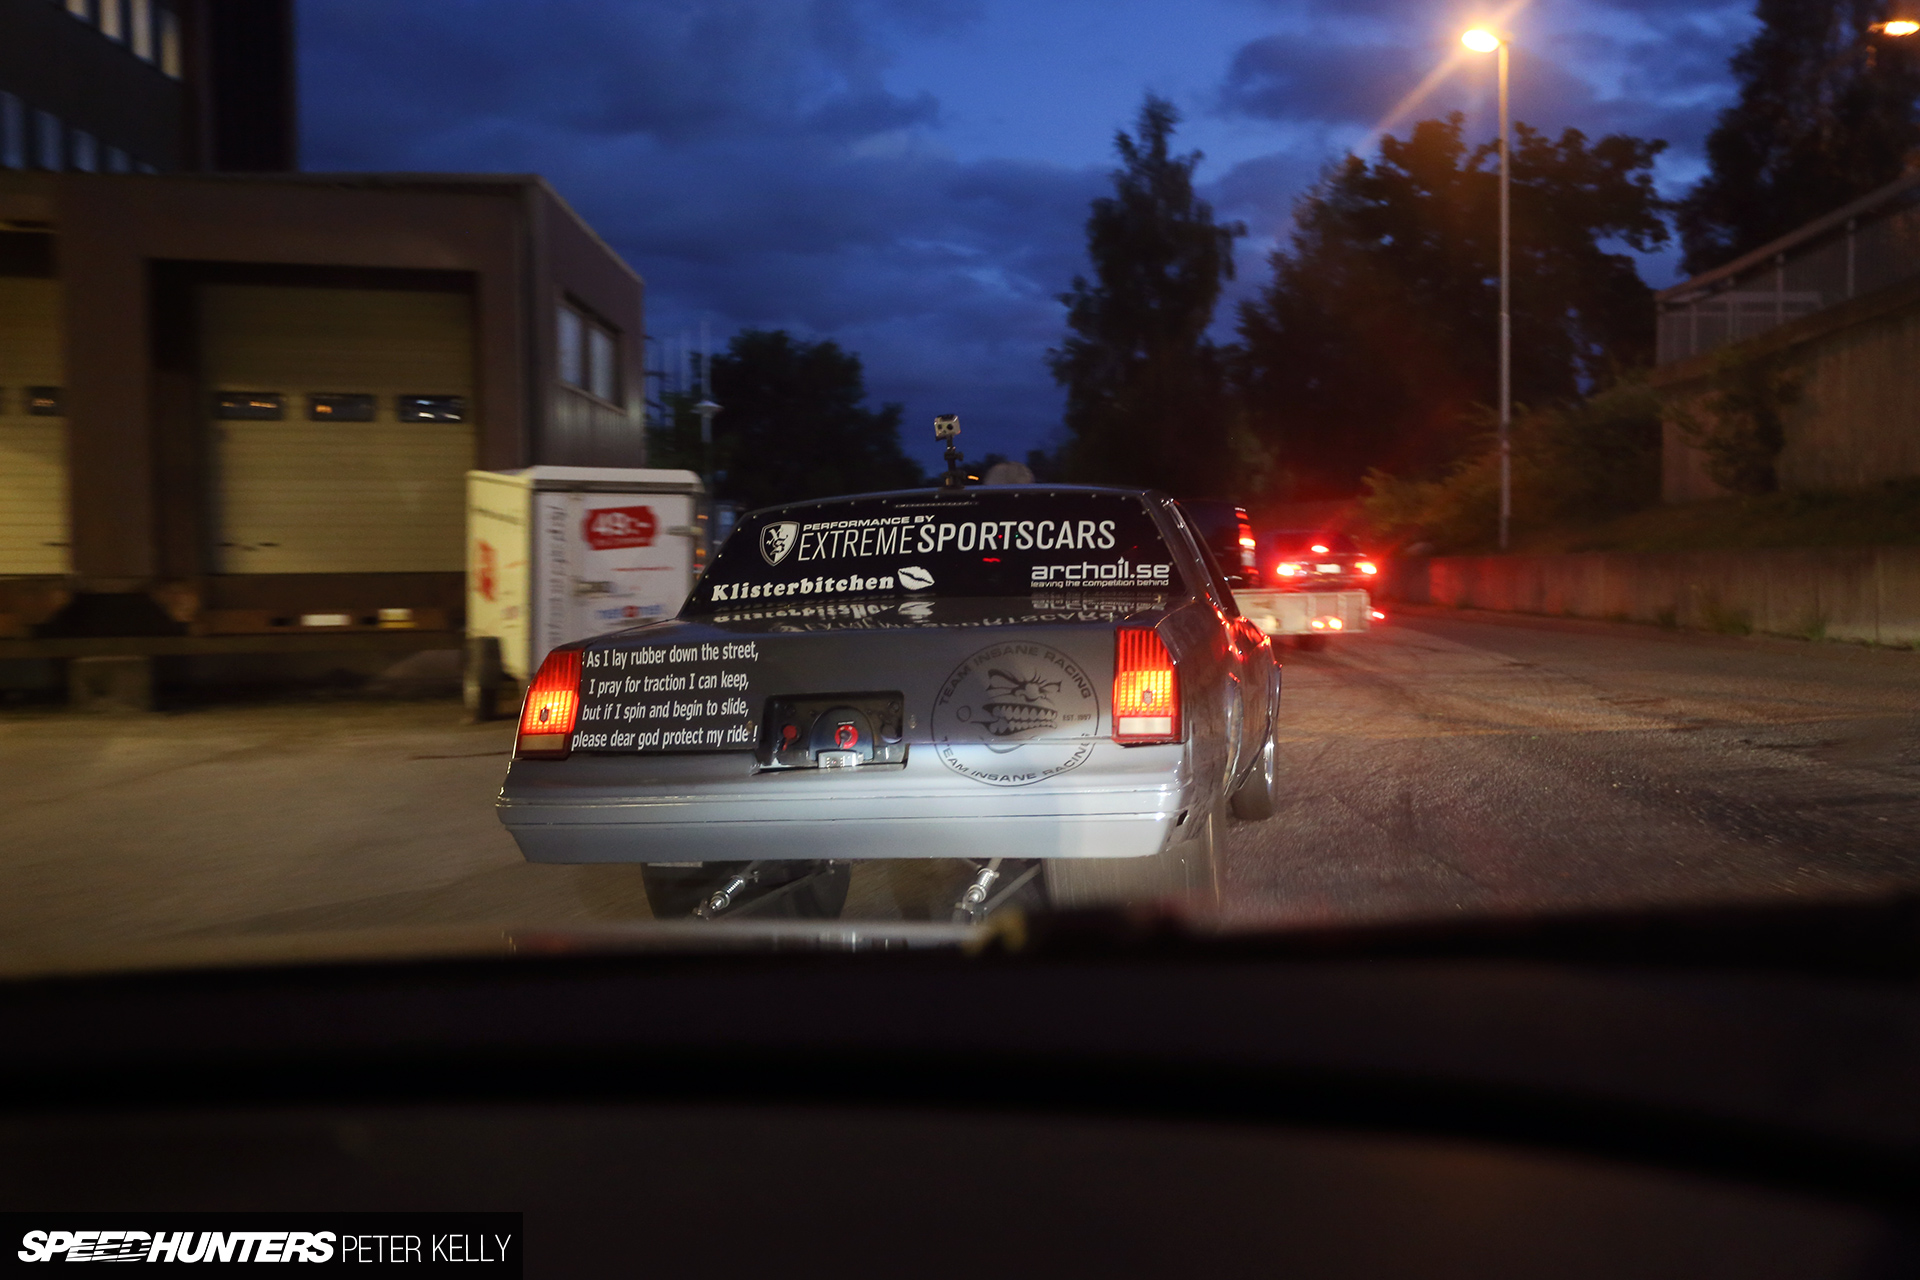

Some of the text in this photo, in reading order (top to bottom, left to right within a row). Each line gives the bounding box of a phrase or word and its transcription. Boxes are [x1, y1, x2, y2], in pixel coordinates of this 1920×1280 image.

[803, 514, 935, 531] PERFORMANCE BY
[1031, 556, 1171, 580] archoil.se
[710, 573, 895, 602] Klisterbitchen
[1030, 578, 1169, 588] leaving the competition behind
[586, 641, 759, 670] As I lay rubber down the street,
[588, 671, 749, 698] I pray for traction I can keep,
[938, 644, 1092, 706] TEAM INSANE RACING
[582, 697, 749, 722] but if I spin and begin to slide,
[571, 731, 608, 751] please
[610, 729, 636, 747] dear
[637, 728, 660, 750] god
[662, 726, 704, 749] protect
[706, 727, 725, 746] my
[970, 769, 1037, 783] INSANE
